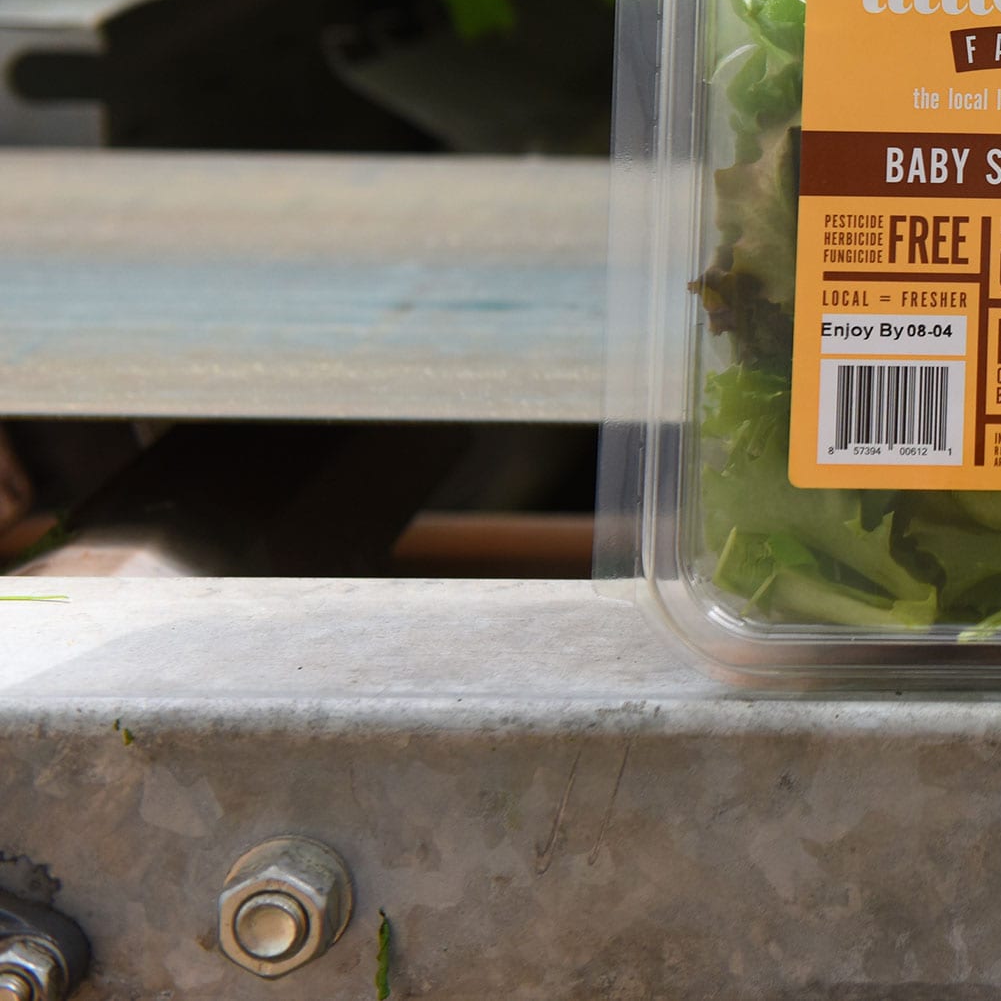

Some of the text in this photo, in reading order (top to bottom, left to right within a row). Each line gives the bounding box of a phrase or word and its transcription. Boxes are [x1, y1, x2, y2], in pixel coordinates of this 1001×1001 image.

[913, 87, 940, 109] the
[948, 88, 988, 110] local
[885, 147, 970, 184] BABY
[824, 214, 884, 229] PESTICIDE
[823, 231, 884, 246] HERBICIDE
[888, 215, 970, 264] FREE
[823, 249, 883, 263] FUNGICIDE
[822, 289, 869, 307] LOCAL
[901, 290, 967, 308] FRESHER
[821, 322, 953, 340] Enjoy By 08-04
[827, 447, 952, 457] 8 57394 00612 1
